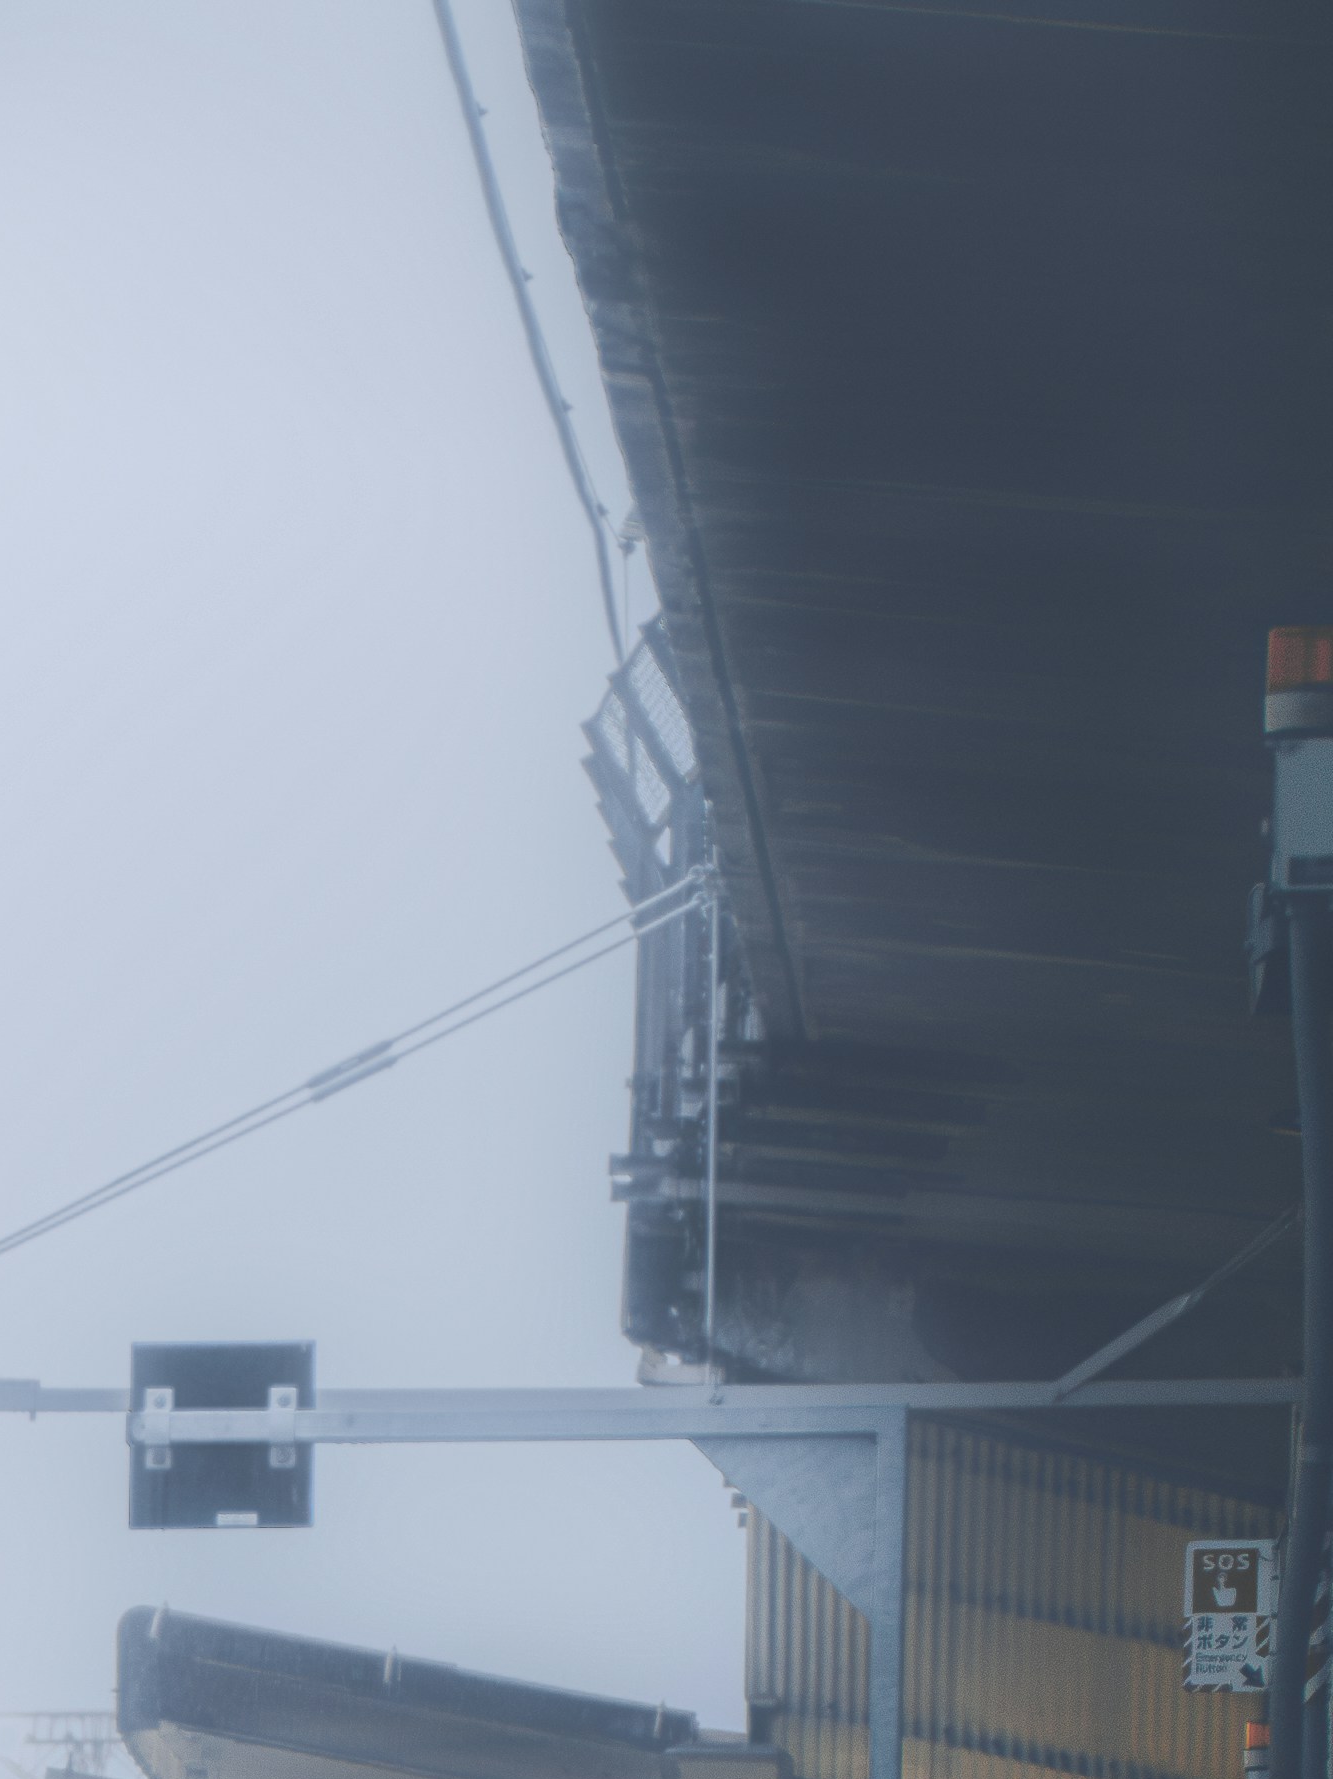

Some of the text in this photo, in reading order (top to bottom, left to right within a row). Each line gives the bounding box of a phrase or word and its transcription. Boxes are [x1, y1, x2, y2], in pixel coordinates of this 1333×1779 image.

[1202, 1553, 1251, 1571] SOS
[1197, 1633, 1249, 1650] ボタン
[1195, 1652, 1248, 1663] Emergency
[1195, 1663, 1228, 1675] Button
